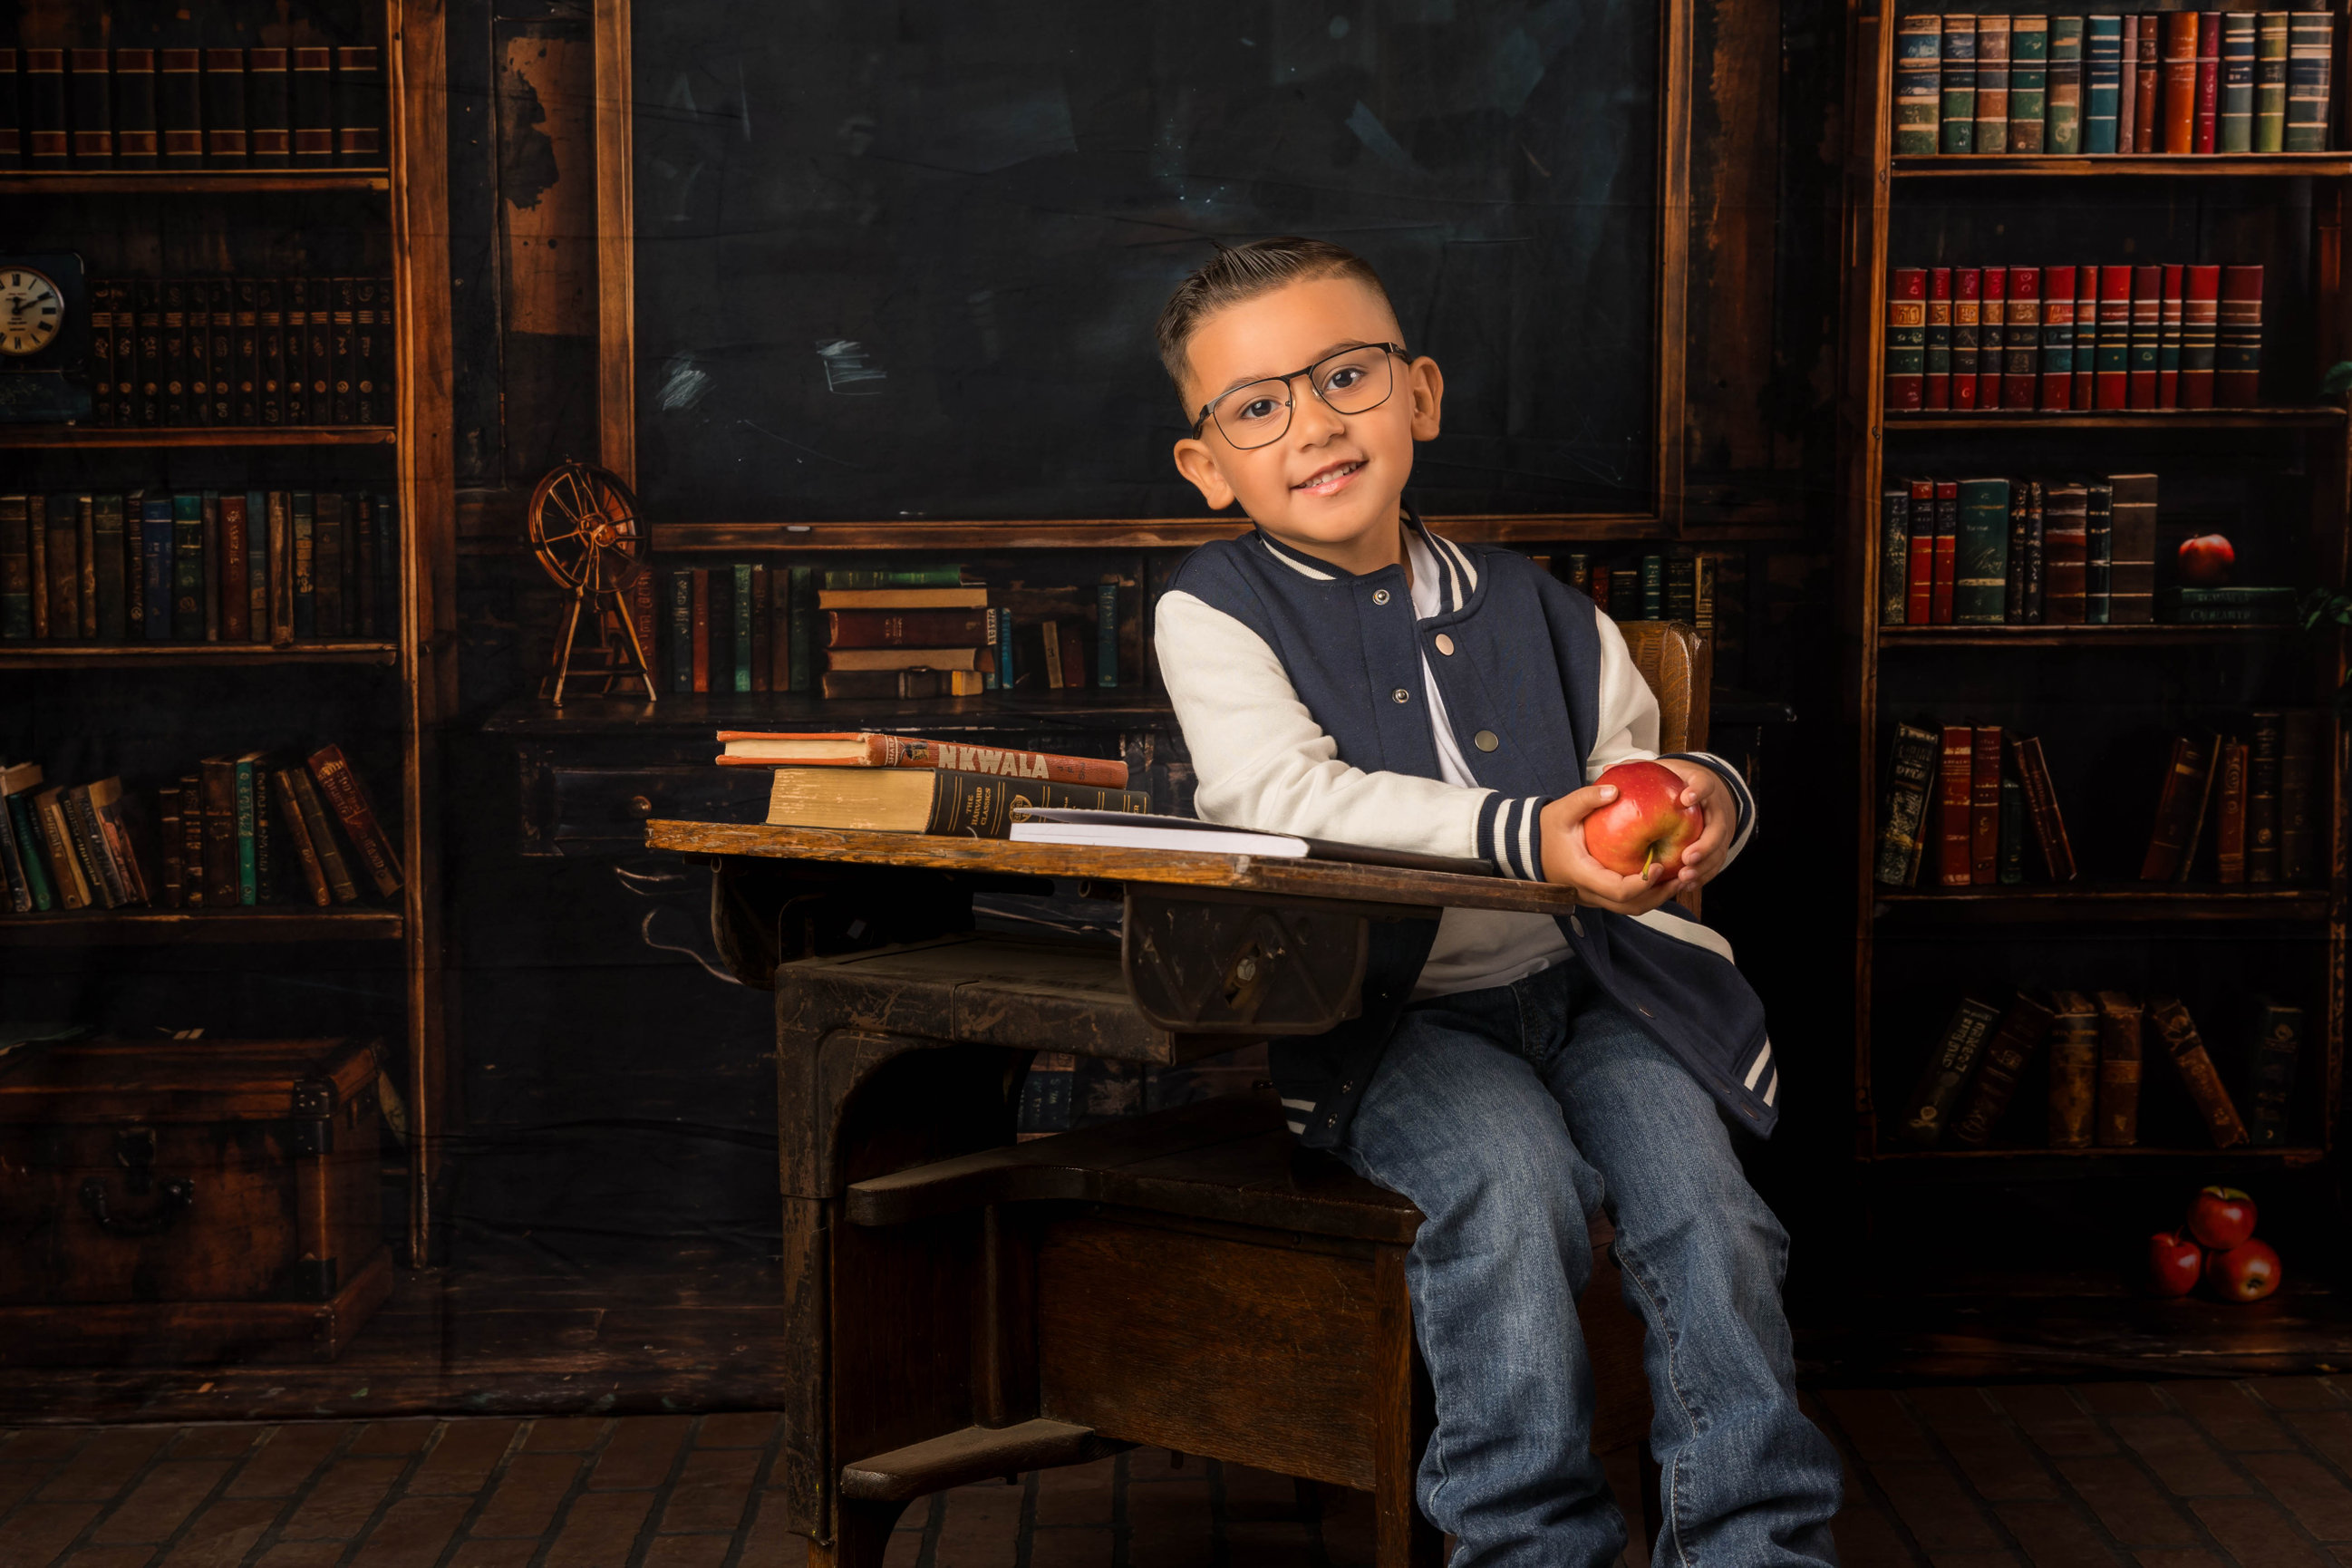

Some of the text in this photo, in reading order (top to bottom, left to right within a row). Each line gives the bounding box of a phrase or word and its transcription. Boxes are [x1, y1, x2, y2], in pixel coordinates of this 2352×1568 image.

[938, 743, 1050, 779] NKWALA
[972, 787, 982, 826] HARVARD
[981, 788, 991, 826] CLASSICS
